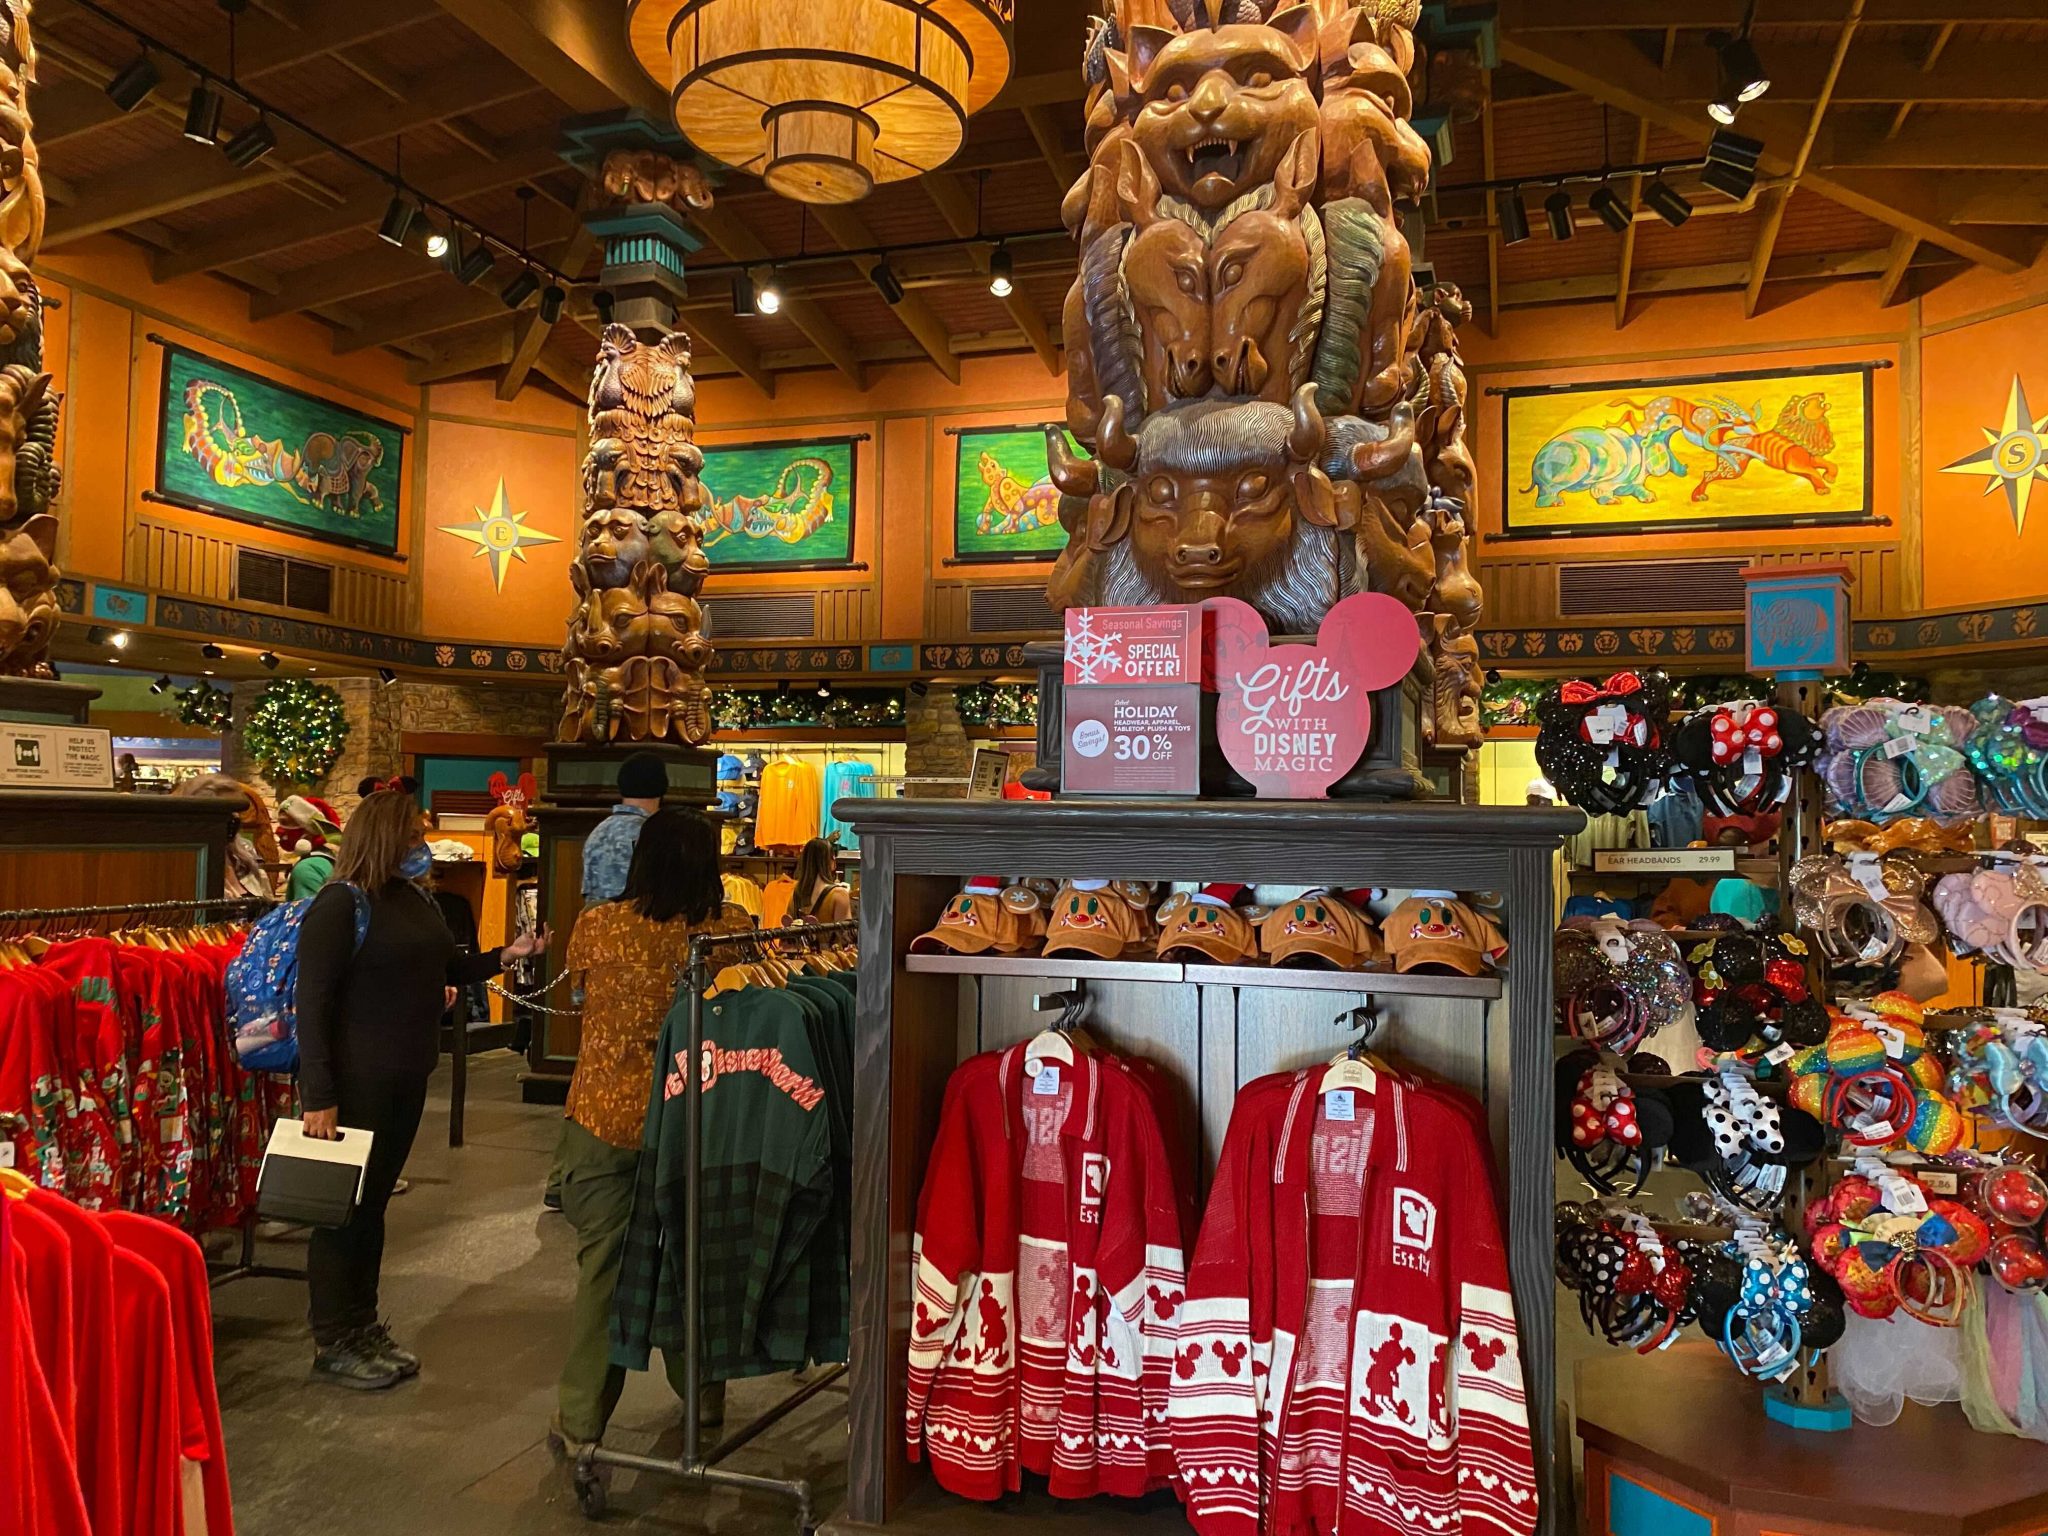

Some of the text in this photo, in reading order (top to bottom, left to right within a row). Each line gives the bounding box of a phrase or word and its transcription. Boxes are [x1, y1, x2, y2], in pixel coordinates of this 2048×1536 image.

[2007, 443, 2026, 465] S
[495, 526, 507, 541] E
[1102, 617, 1182, 631] Seasonal Savings
[1127, 643, 1180, 659] SPECIAL
[1124, 659, 1180, 677] OFFER!
[1235, 657, 1349, 735] Gifts
[1114, 706, 1178, 719] HOLIDAY
[1274, 718, 1328, 731] WITH
[1080, 728, 1100, 740] Bonus
[68, 745, 96, 753] PROTECT
[1254, 733, 1337, 755] DISNEY
[1152, 751, 1173, 760] OFF
[1254, 757, 1333, 772] MAGIC
[1607, 856, 1721, 865] EAR HEADBANDS 29.99
